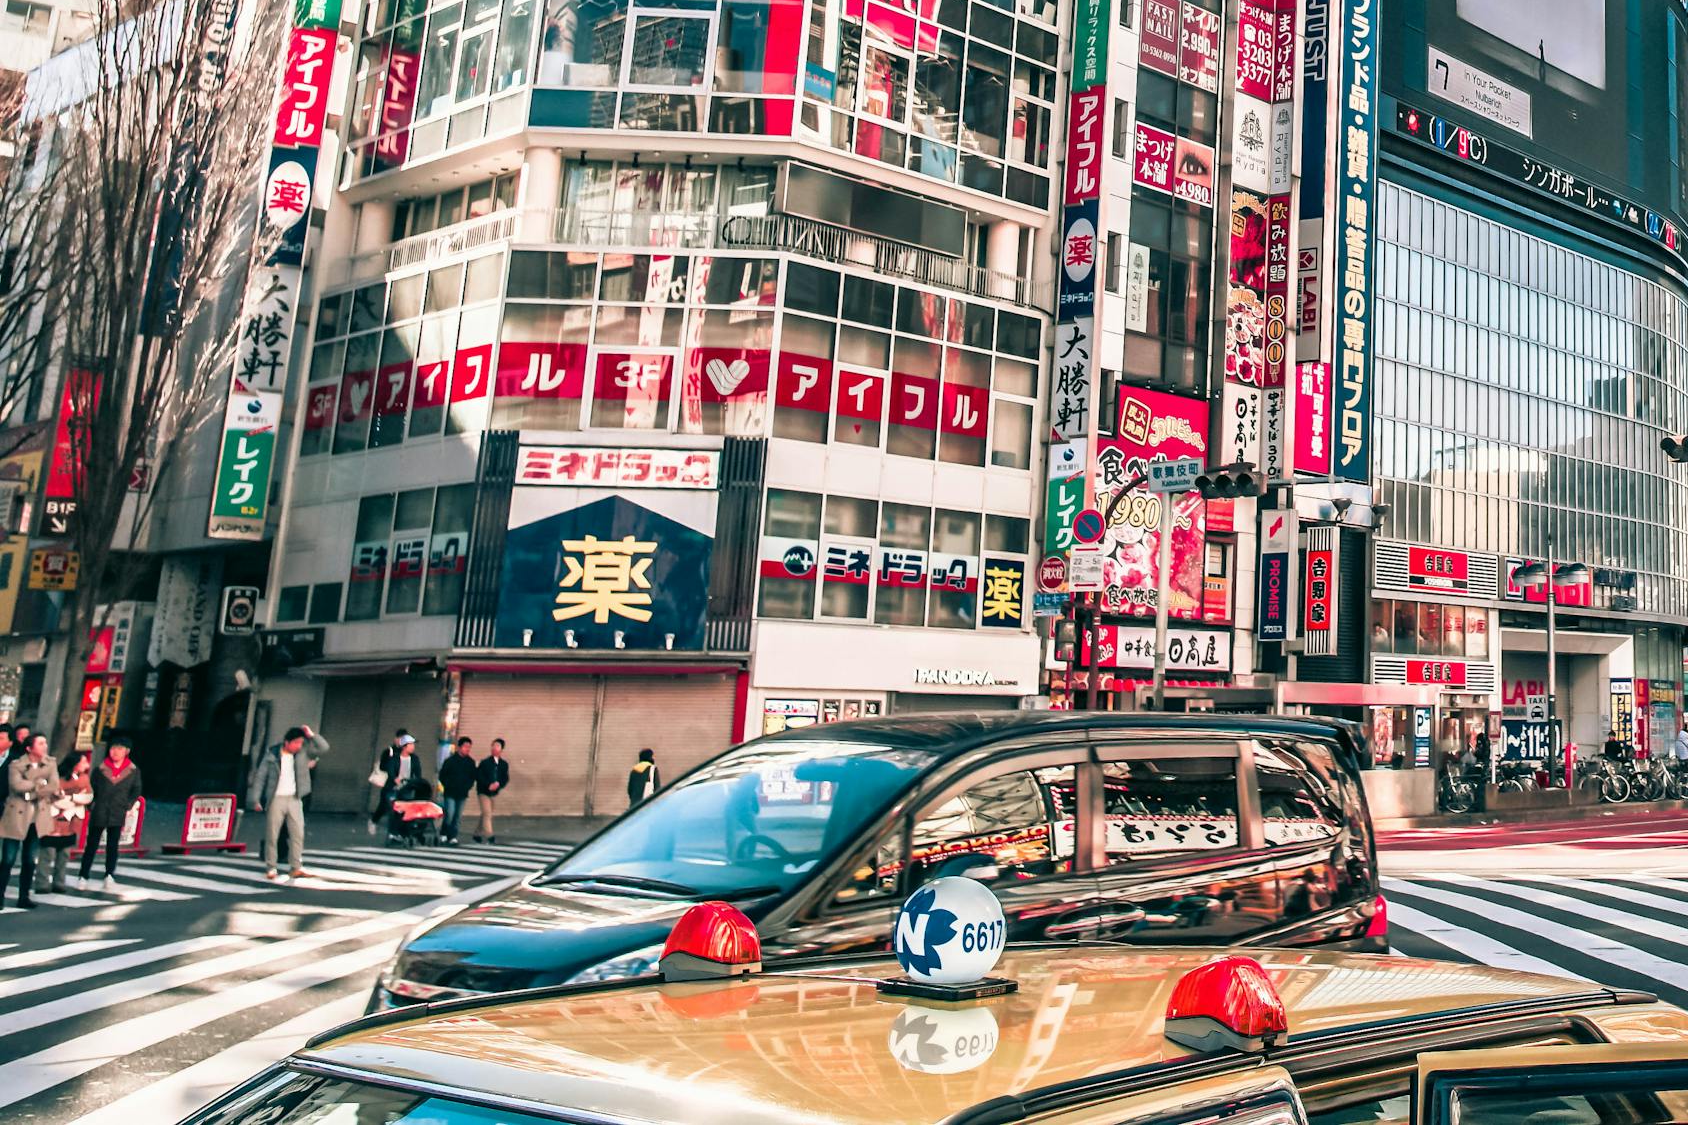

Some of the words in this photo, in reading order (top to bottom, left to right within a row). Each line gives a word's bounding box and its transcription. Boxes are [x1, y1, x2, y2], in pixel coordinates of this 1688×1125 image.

[1147, 2, 1174, 24] FAST
[1147, 18, 1174, 40] NAIL
[1183, 5, 1219, 32] ネイル
[1239, 0, 1273, 26] まつげ本舗
[1257, 28, 1272, 49] 03
[1276, 14, 1294, 102] まつげ本舗
[1435, 58, 1450, 91] 7
[285, 34, 326, 137] アイフル
[1471, 74, 1489, 91] Your
[1489, 81, 1512, 101] Pocket
[1074, 95, 1100, 196] アイフル
[1136, 132, 1174, 163] まつげ
[1273, 133, 1283, 184] Rydia
[1139, 161, 1169, 186] 本舗
[1235, 156, 1266, 175] Rydia
[268, 179, 307, 213] 薬
[1067, 232, 1094, 267] 薬
[1270, 203, 1288, 283] 飲み放題
[1302, 275, 1317, 333] LABI
[238, 275, 290, 387] 大勝軒
[387, 353, 566, 411] アイフル
[614, 360, 662, 388] 3F
[1054, 325, 1088, 433] 大勝軒
[312, 391, 333, 418] 3F
[791, 363, 978, 429] アイフル
[228, 437, 260, 505] レイク
[1152, 462, 1199, 481] 歌舞伎町
[1161, 478, 1191, 488] Kabukicho
[46, 501, 77, 515] B1F
[1054, 484, 1077, 551] レイク
[552, 534, 659, 624] 薬
[825, 545, 969, 591] ミネドラッグ
[1042, 566, 1064, 580] 消火栓
[1424, 554, 1453, 574] 吉野家
[983, 566, 1023, 621] 薬
[1267, 559, 1281, 620] PROMISE
[1311, 557, 1328, 623] 吉野家
[1169, 635, 1219, 667] 日高屋
[913, 667, 995, 686] PANDORA
[1422, 662, 1452, 682] 吉野家
[962, 919, 1005, 953] 6617
